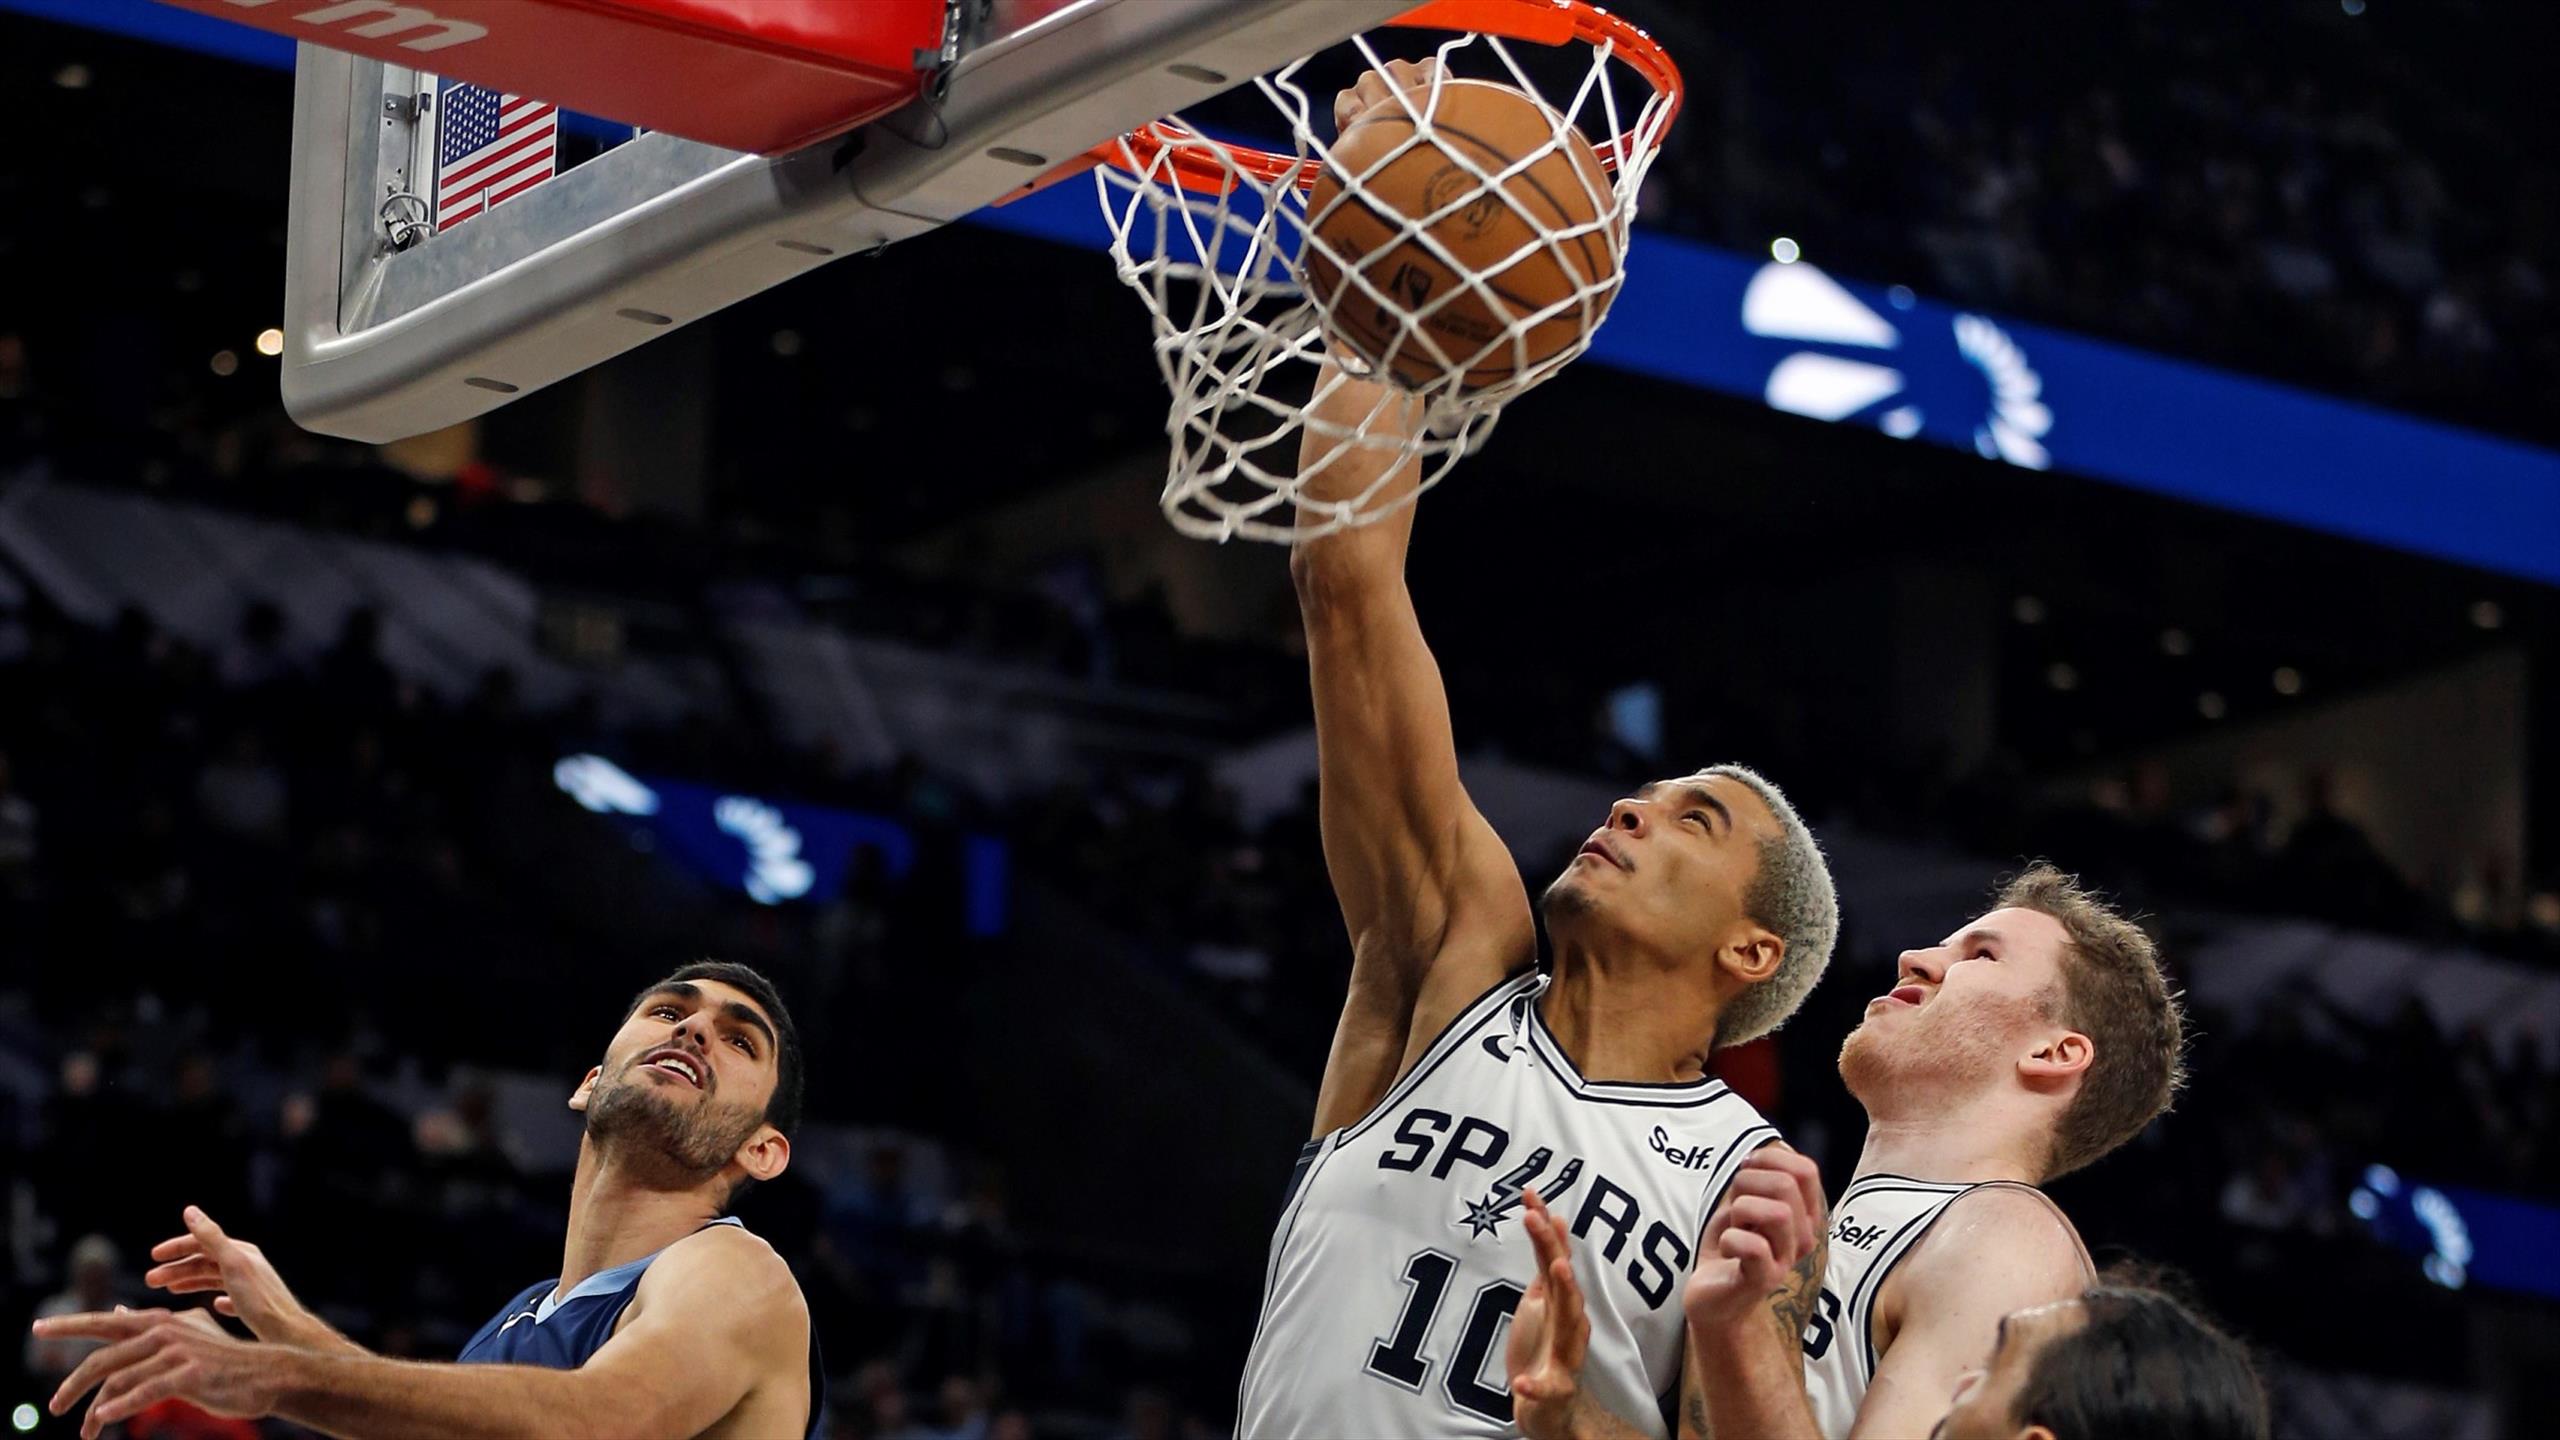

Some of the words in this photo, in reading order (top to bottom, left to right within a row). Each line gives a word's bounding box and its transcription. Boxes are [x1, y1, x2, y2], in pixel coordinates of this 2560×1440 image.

[222, 0, 489, 51] m
[1648, 1125, 1714, 1170] Self.
[1378, 1107, 1691, 1311] SPURS
[1829, 1215, 1888, 1251] Self.
[1362, 1246, 1528, 1428] 10
